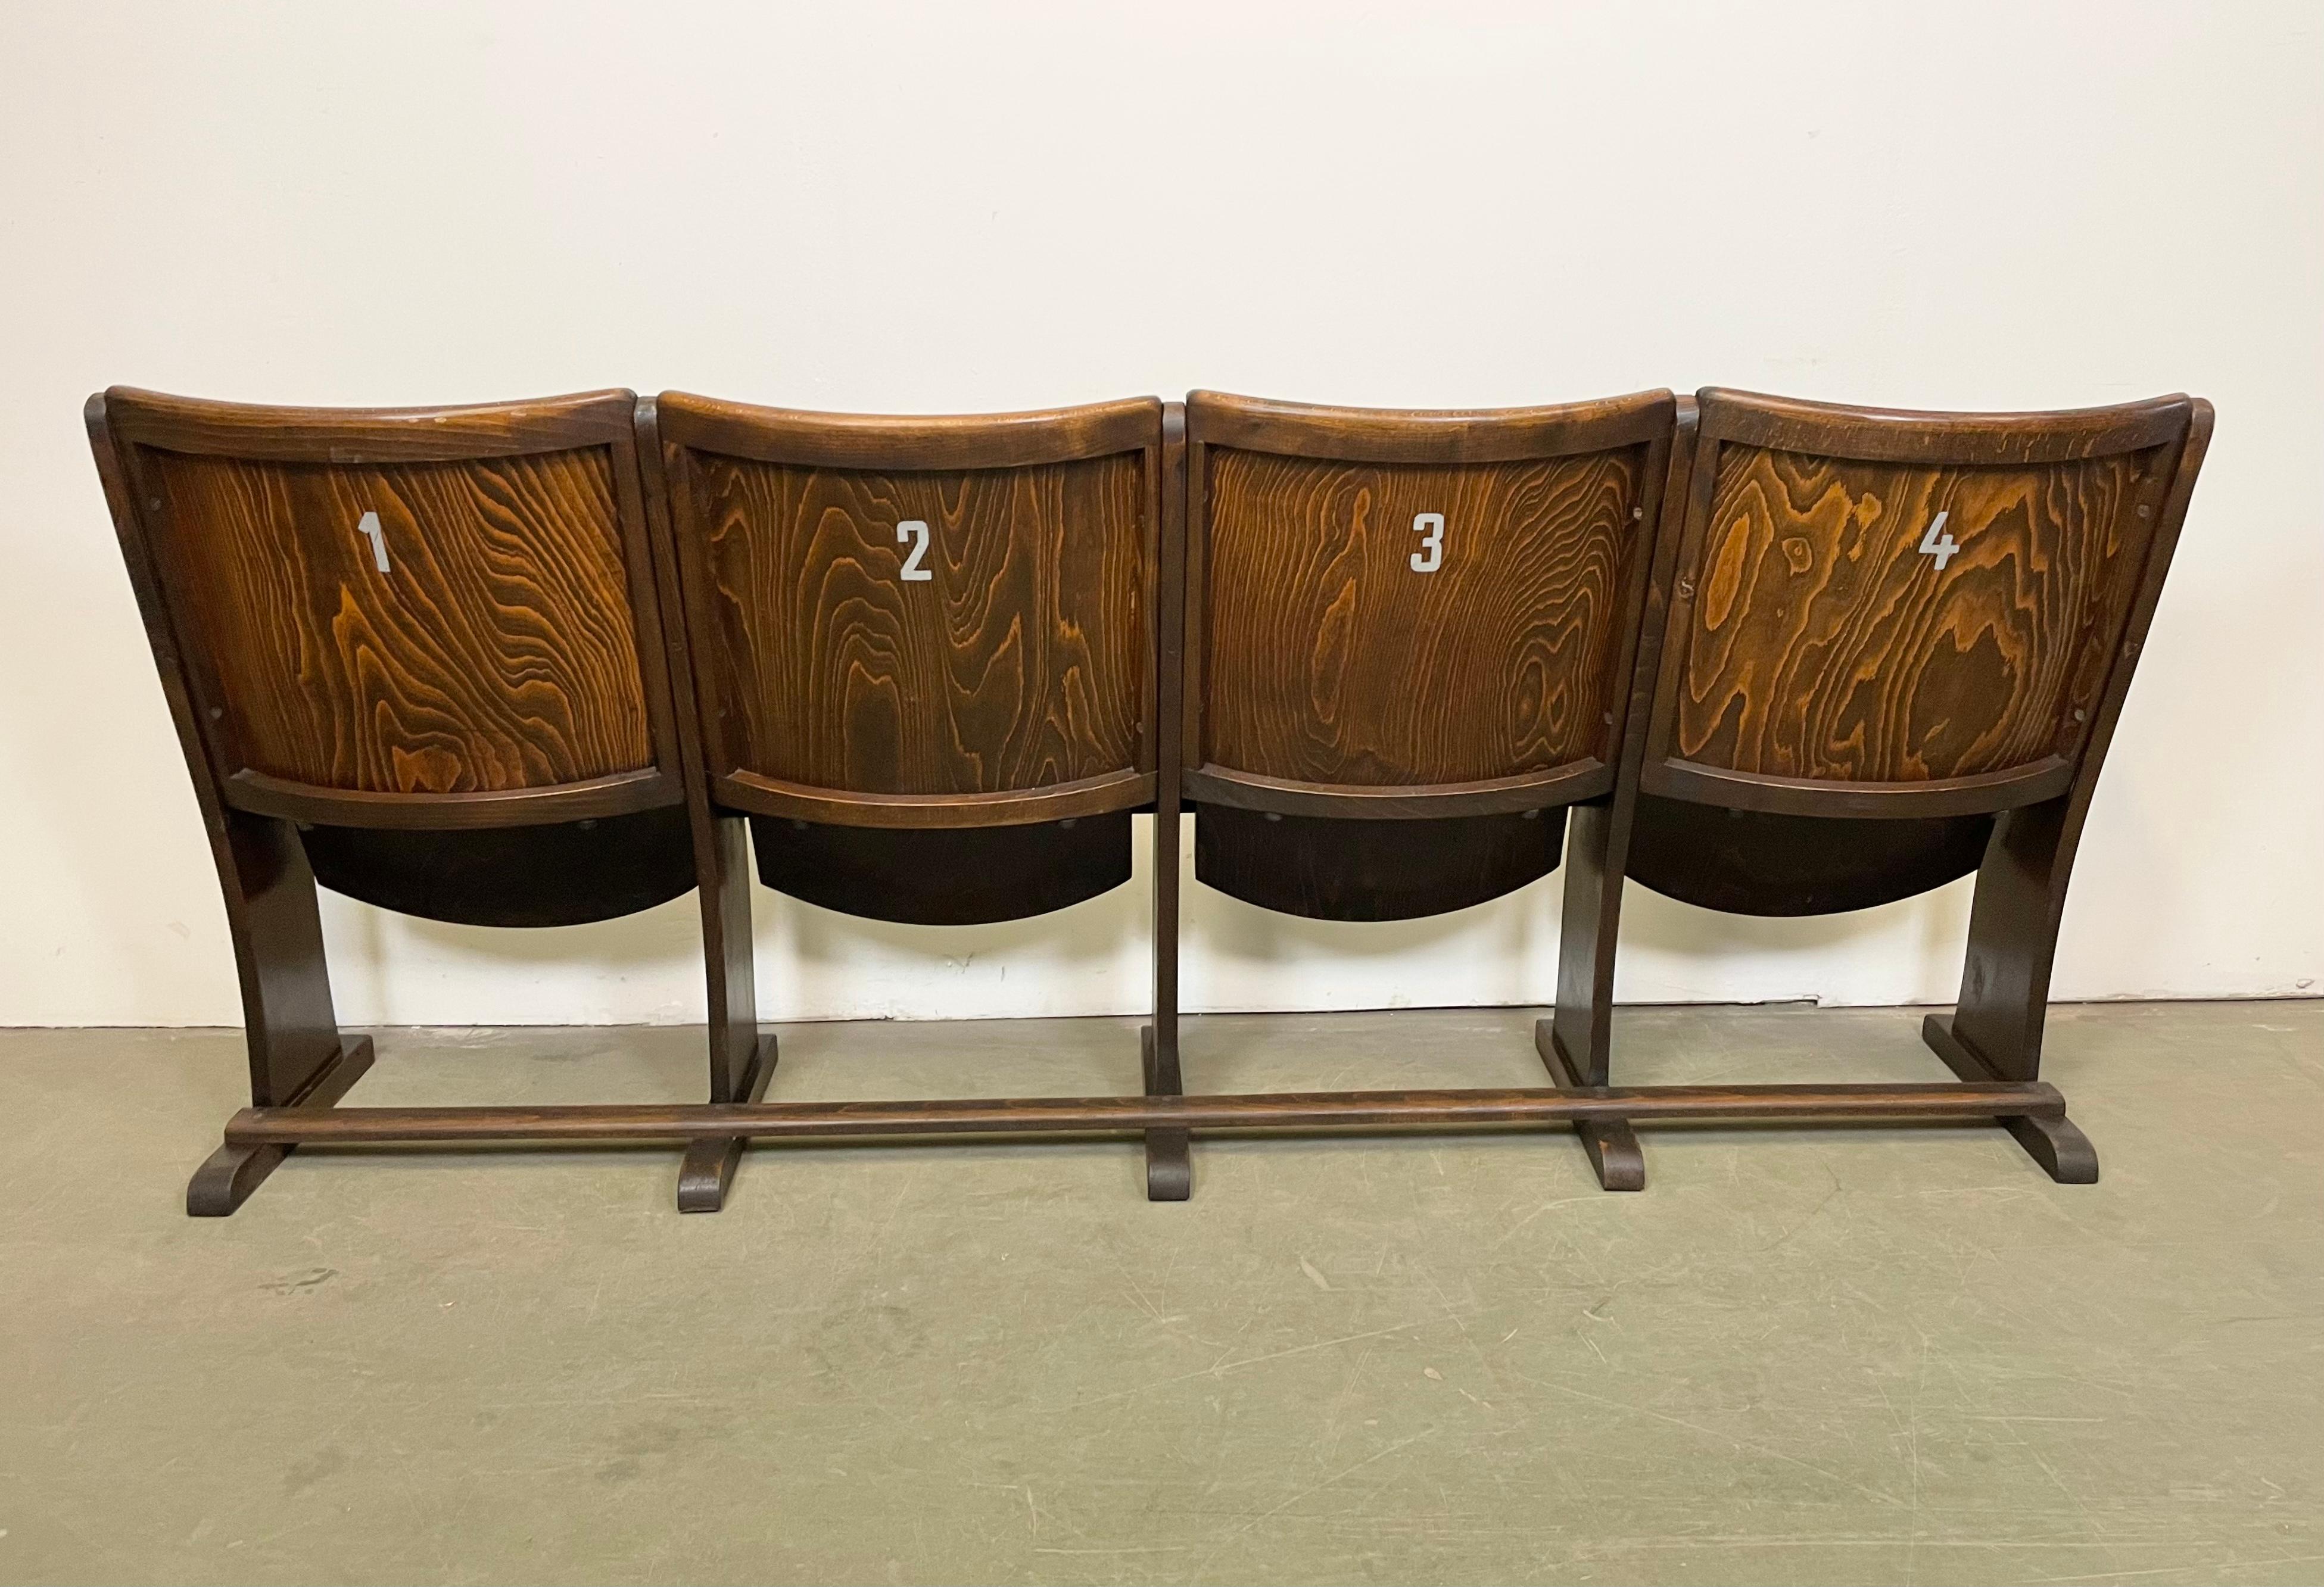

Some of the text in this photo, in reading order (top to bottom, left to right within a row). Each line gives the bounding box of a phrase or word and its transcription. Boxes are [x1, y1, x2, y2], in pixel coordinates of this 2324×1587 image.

[358, 512, 391, 572] 1
[896, 520, 932, 581] 2
[1410, 513, 1444, 572] 3
[1918, 511, 1960, 570] 4
